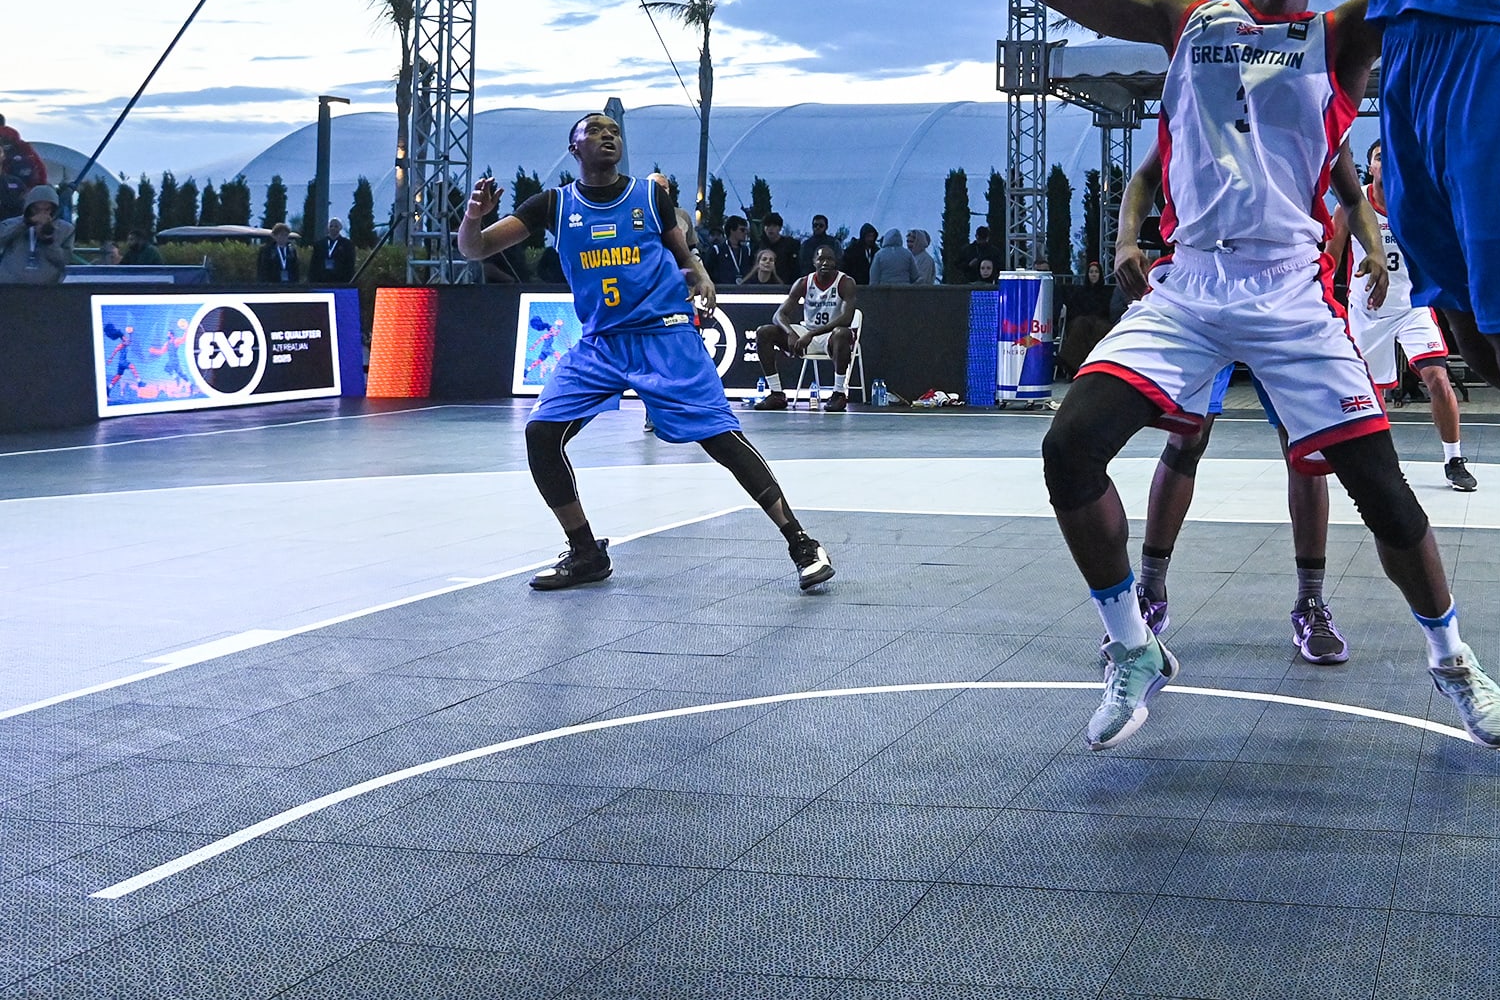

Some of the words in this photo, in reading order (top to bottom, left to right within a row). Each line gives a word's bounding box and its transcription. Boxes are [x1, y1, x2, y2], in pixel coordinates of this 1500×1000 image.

[1192, 45, 1240, 64] GREAT
[1241, 46, 1305, 70] BRITAIN
[580, 246, 641, 270] RWANDA
[1386, 252, 1400, 271] 3
[602, 278, 621, 307] 5
[814, 312, 830, 325] 99
[1031, 319, 1052, 334] Bull
[197, 330, 255, 370] 3X3
